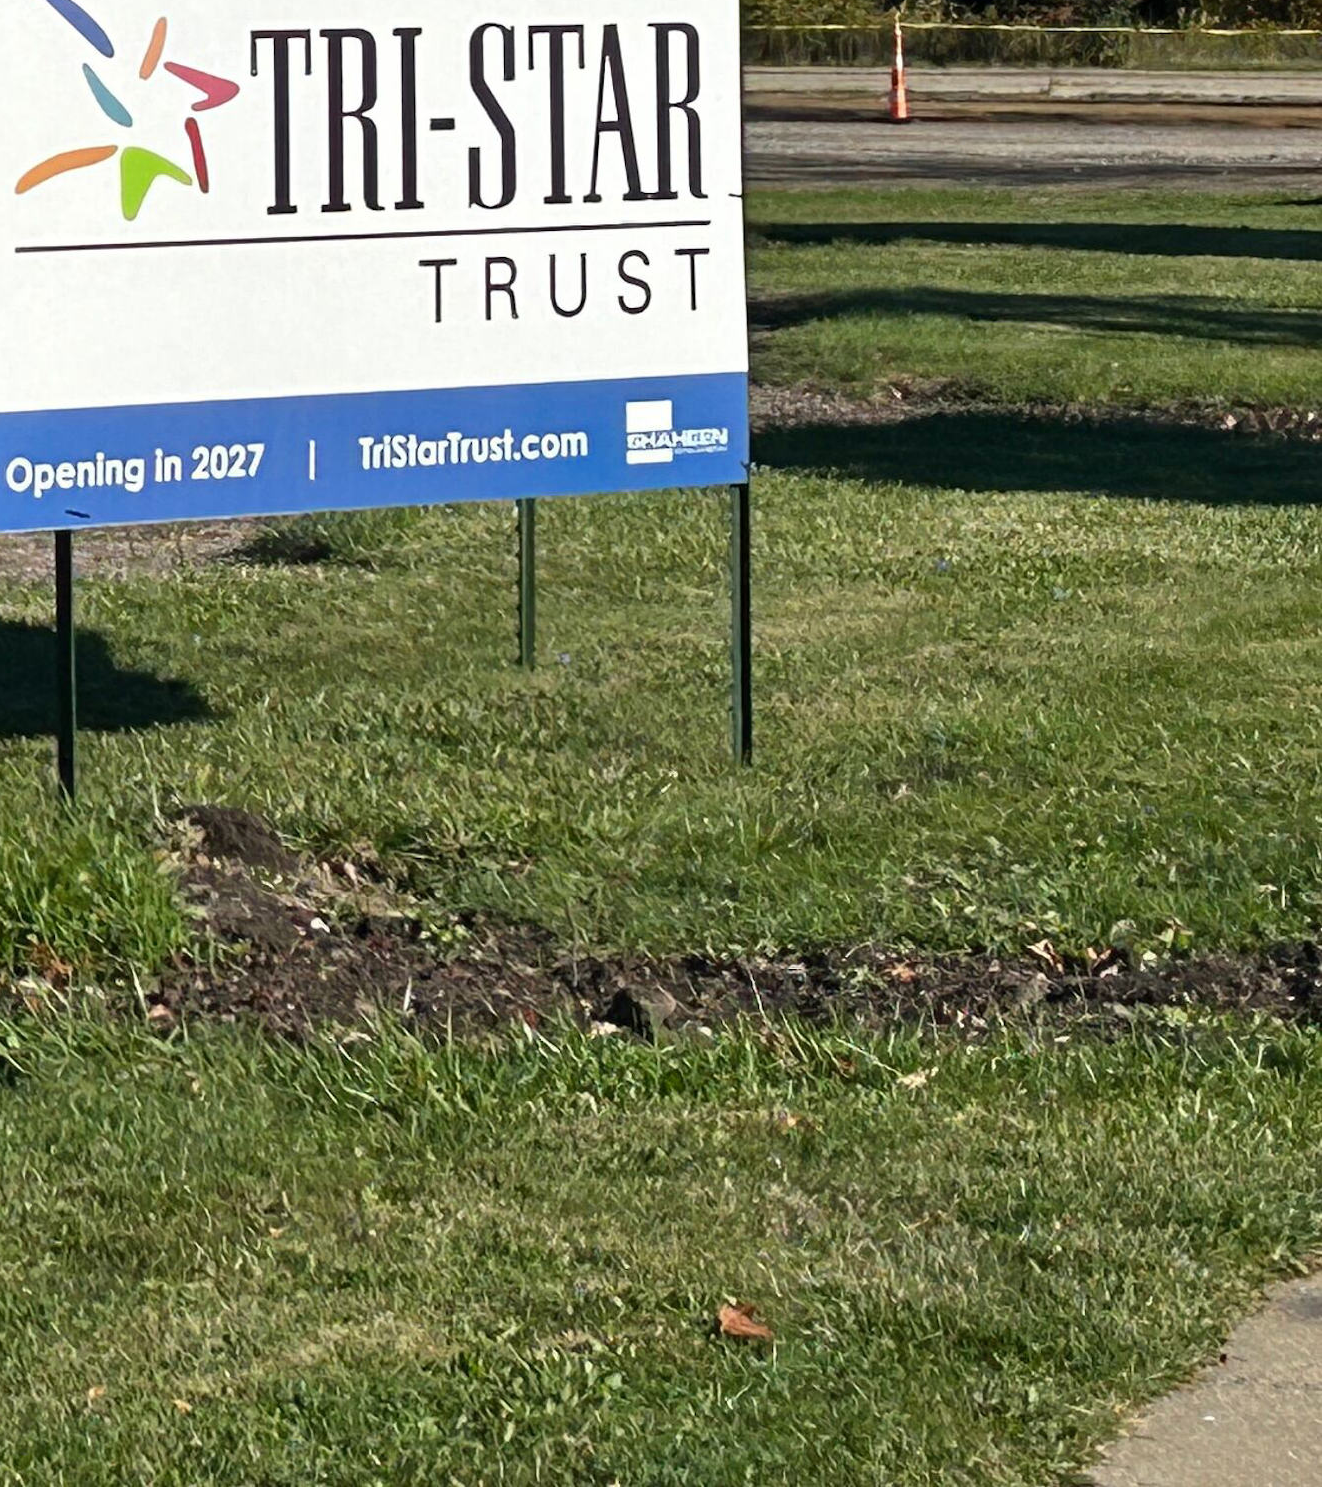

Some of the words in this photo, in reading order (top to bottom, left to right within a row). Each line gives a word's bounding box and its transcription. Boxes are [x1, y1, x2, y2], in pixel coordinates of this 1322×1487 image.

[250, 22, 709, 216] TRI-STAR
[418, 247, 710, 323] TRUST
[5, 451, 145, 499] Opening
[154, 448, 182, 483] in
[191, 443, 265, 480] 2027
[358, 428, 588, 471] TriStarTrust.com
